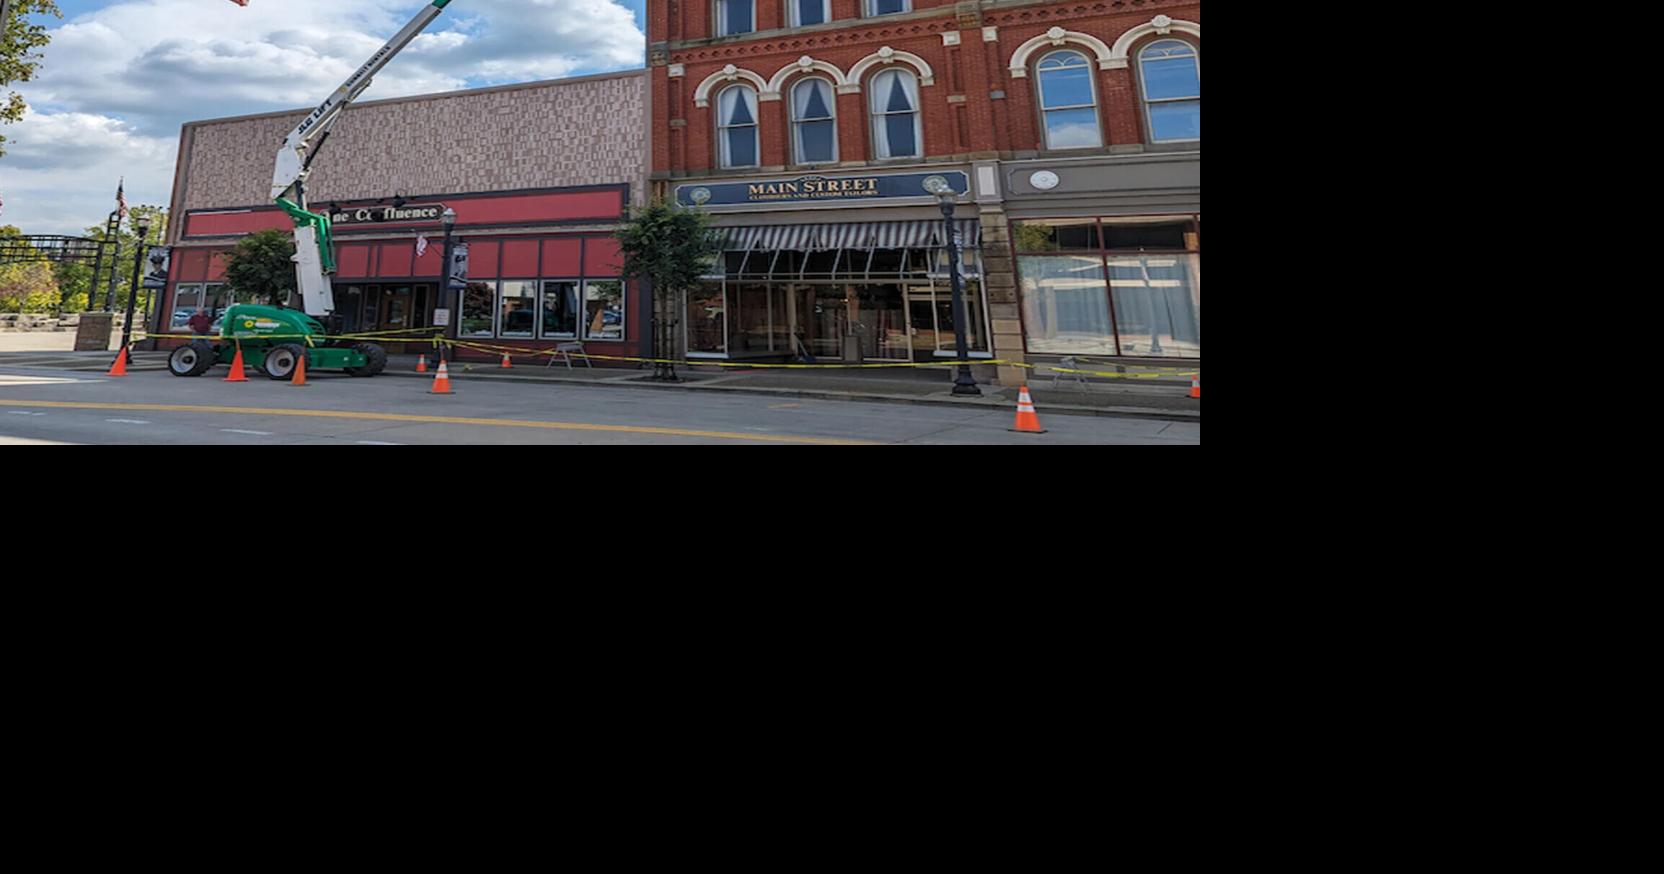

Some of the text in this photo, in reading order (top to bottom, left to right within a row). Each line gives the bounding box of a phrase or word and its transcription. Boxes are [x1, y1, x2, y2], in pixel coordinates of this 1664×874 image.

[313, 98, 332, 119] LIFT
[749, 179, 879, 195] MAIN STREET
[355, 207, 438, 222] Cofluence
